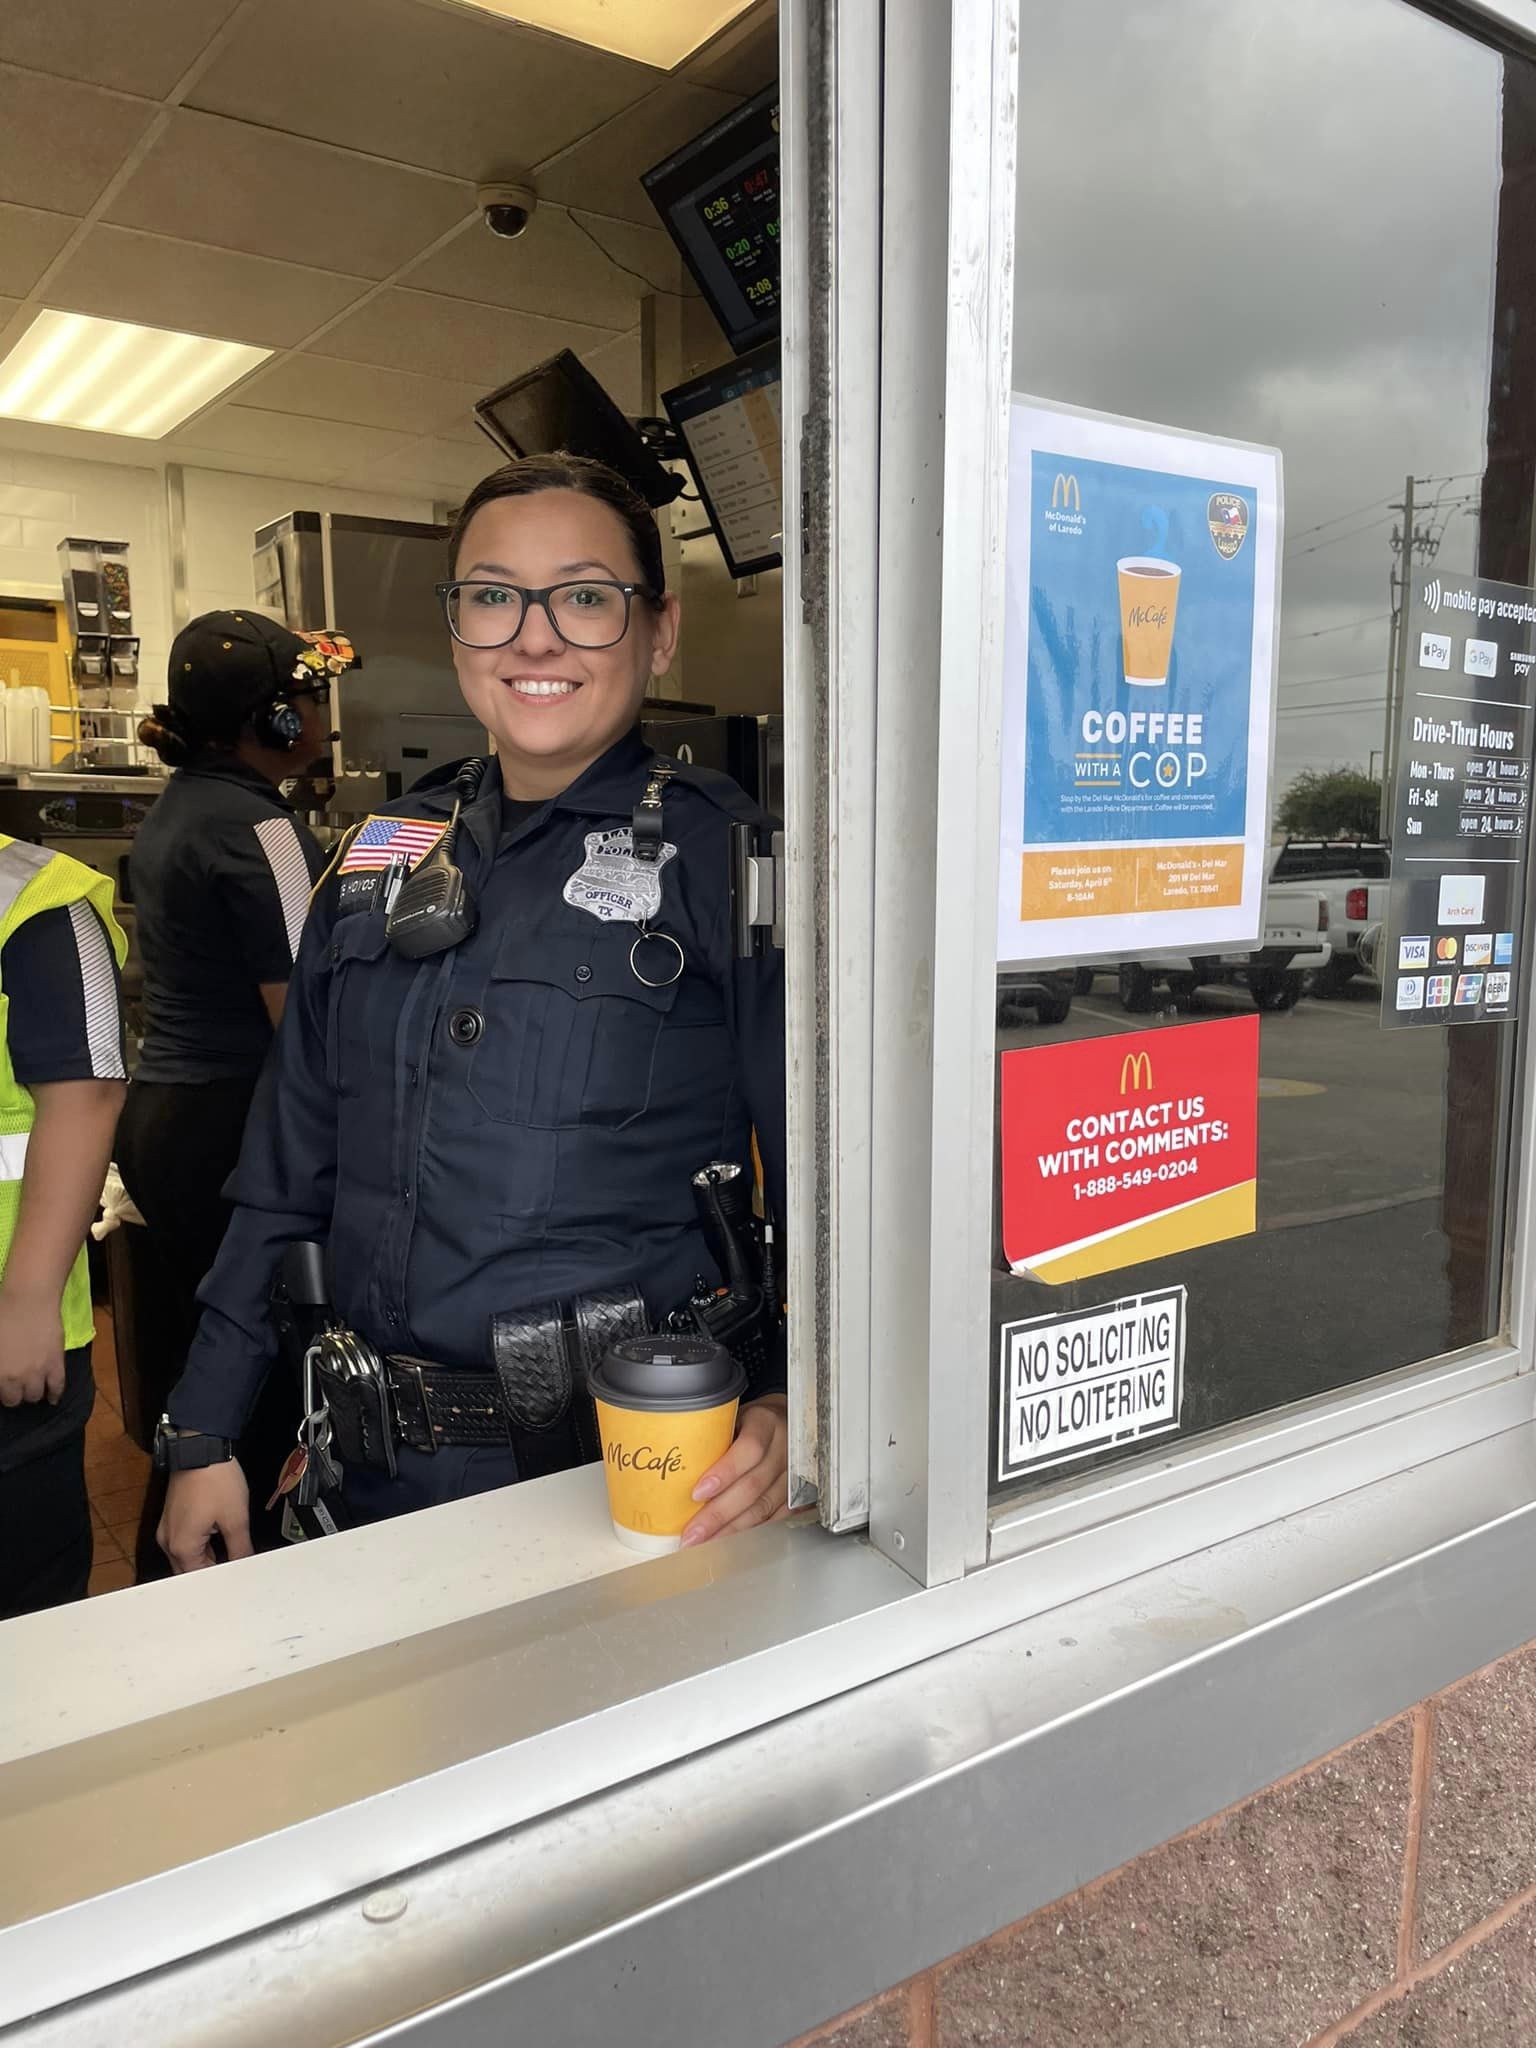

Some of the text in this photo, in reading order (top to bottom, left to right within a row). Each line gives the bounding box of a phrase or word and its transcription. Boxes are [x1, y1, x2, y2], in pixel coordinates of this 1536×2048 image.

[704, 197, 728, 220] 0:36
[726, 238, 750, 260] 0:20
[746, 278, 772, 300] 2:08
[1044, 510, 1086, 524] McDonald's
[1049, 522, 1082, 535] of Laredo
[1443, 589, 1476, 612] mobile
[1478, 598, 1496, 620] pay
[1128, 605, 1168, 628] McCafé
[1432, 644, 1448, 662] Pay
[1480, 652, 1494, 669] Pay
[1514, 664, 1530, 676] pay
[1082, 710, 1204, 744] COFFEE
[1413, 716, 1514, 750] Drive-Thru Hours
[1075, 751, 1207, 788] WITH A COP
[1410, 761, 1428, 778] Mon
[1433, 762, 1454, 780] Thurs
[1466, 760, 1518, 778] open 24 hours
[1408, 788, 1420, 806] Fri
[1425, 789, 1438, 806] Sat
[1465, 787, 1517, 804] open 24 hours
[1406, 817, 1422, 834] Sun
[1461, 816, 1513, 832] open 24 hours
[1050, 866, 1075, 876] Please
[1076, 865, 1090, 876] join
[1156, 860, 1228, 870] McDonald's Del Mar
[1048, 880, 1082, 890] Saturday,
[1084, 878, 1102, 890] April
[586, 891, 632, 909] OFFICER
[598, 906, 614, 916] TX
[1461, 906, 1474, 916] Card
[1404, 945, 1426, 959] VISA
[1488, 982, 1508, 994] DEBIT
[1066, 1096, 1204, 1142] CONTACT US
[1038, 1120, 1228, 1178] WITH COMMENTS:
[1073, 1157, 1198, 1200] 1-888-549-0204
[1018, 1312, 1170, 1387] NO SOLICITING
[1020, 1369, 1166, 1446] NO LOITERING
[608, 1442, 683, 1480] McCafé
